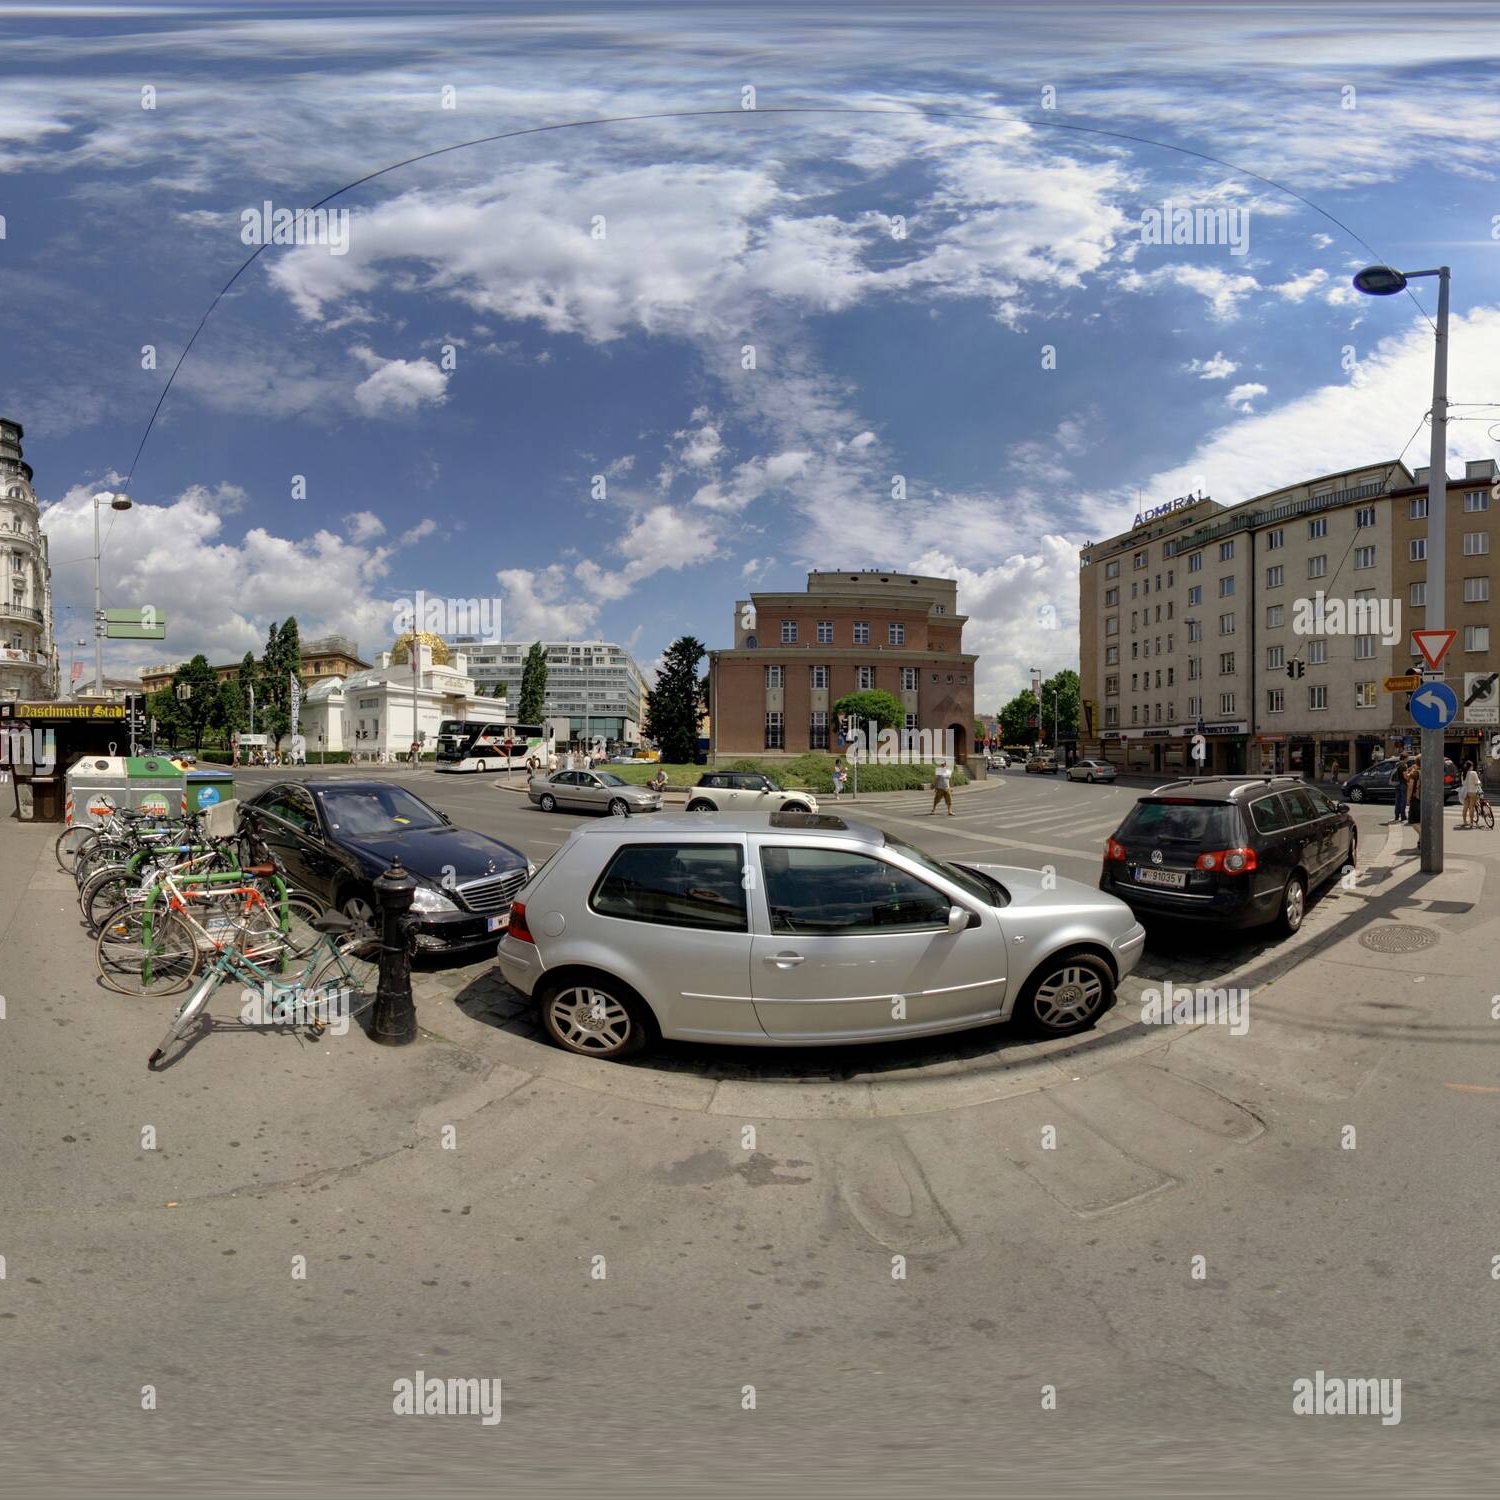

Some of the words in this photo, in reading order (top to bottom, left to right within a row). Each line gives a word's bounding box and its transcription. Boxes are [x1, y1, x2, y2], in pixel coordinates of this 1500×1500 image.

[1132, 489, 1203, 531] ADMIRAL
[19, 704, 90, 717] Naschmarkt
[92, 704, 126, 717] Stadl
[1153, 872, 1176, 883] 91035
